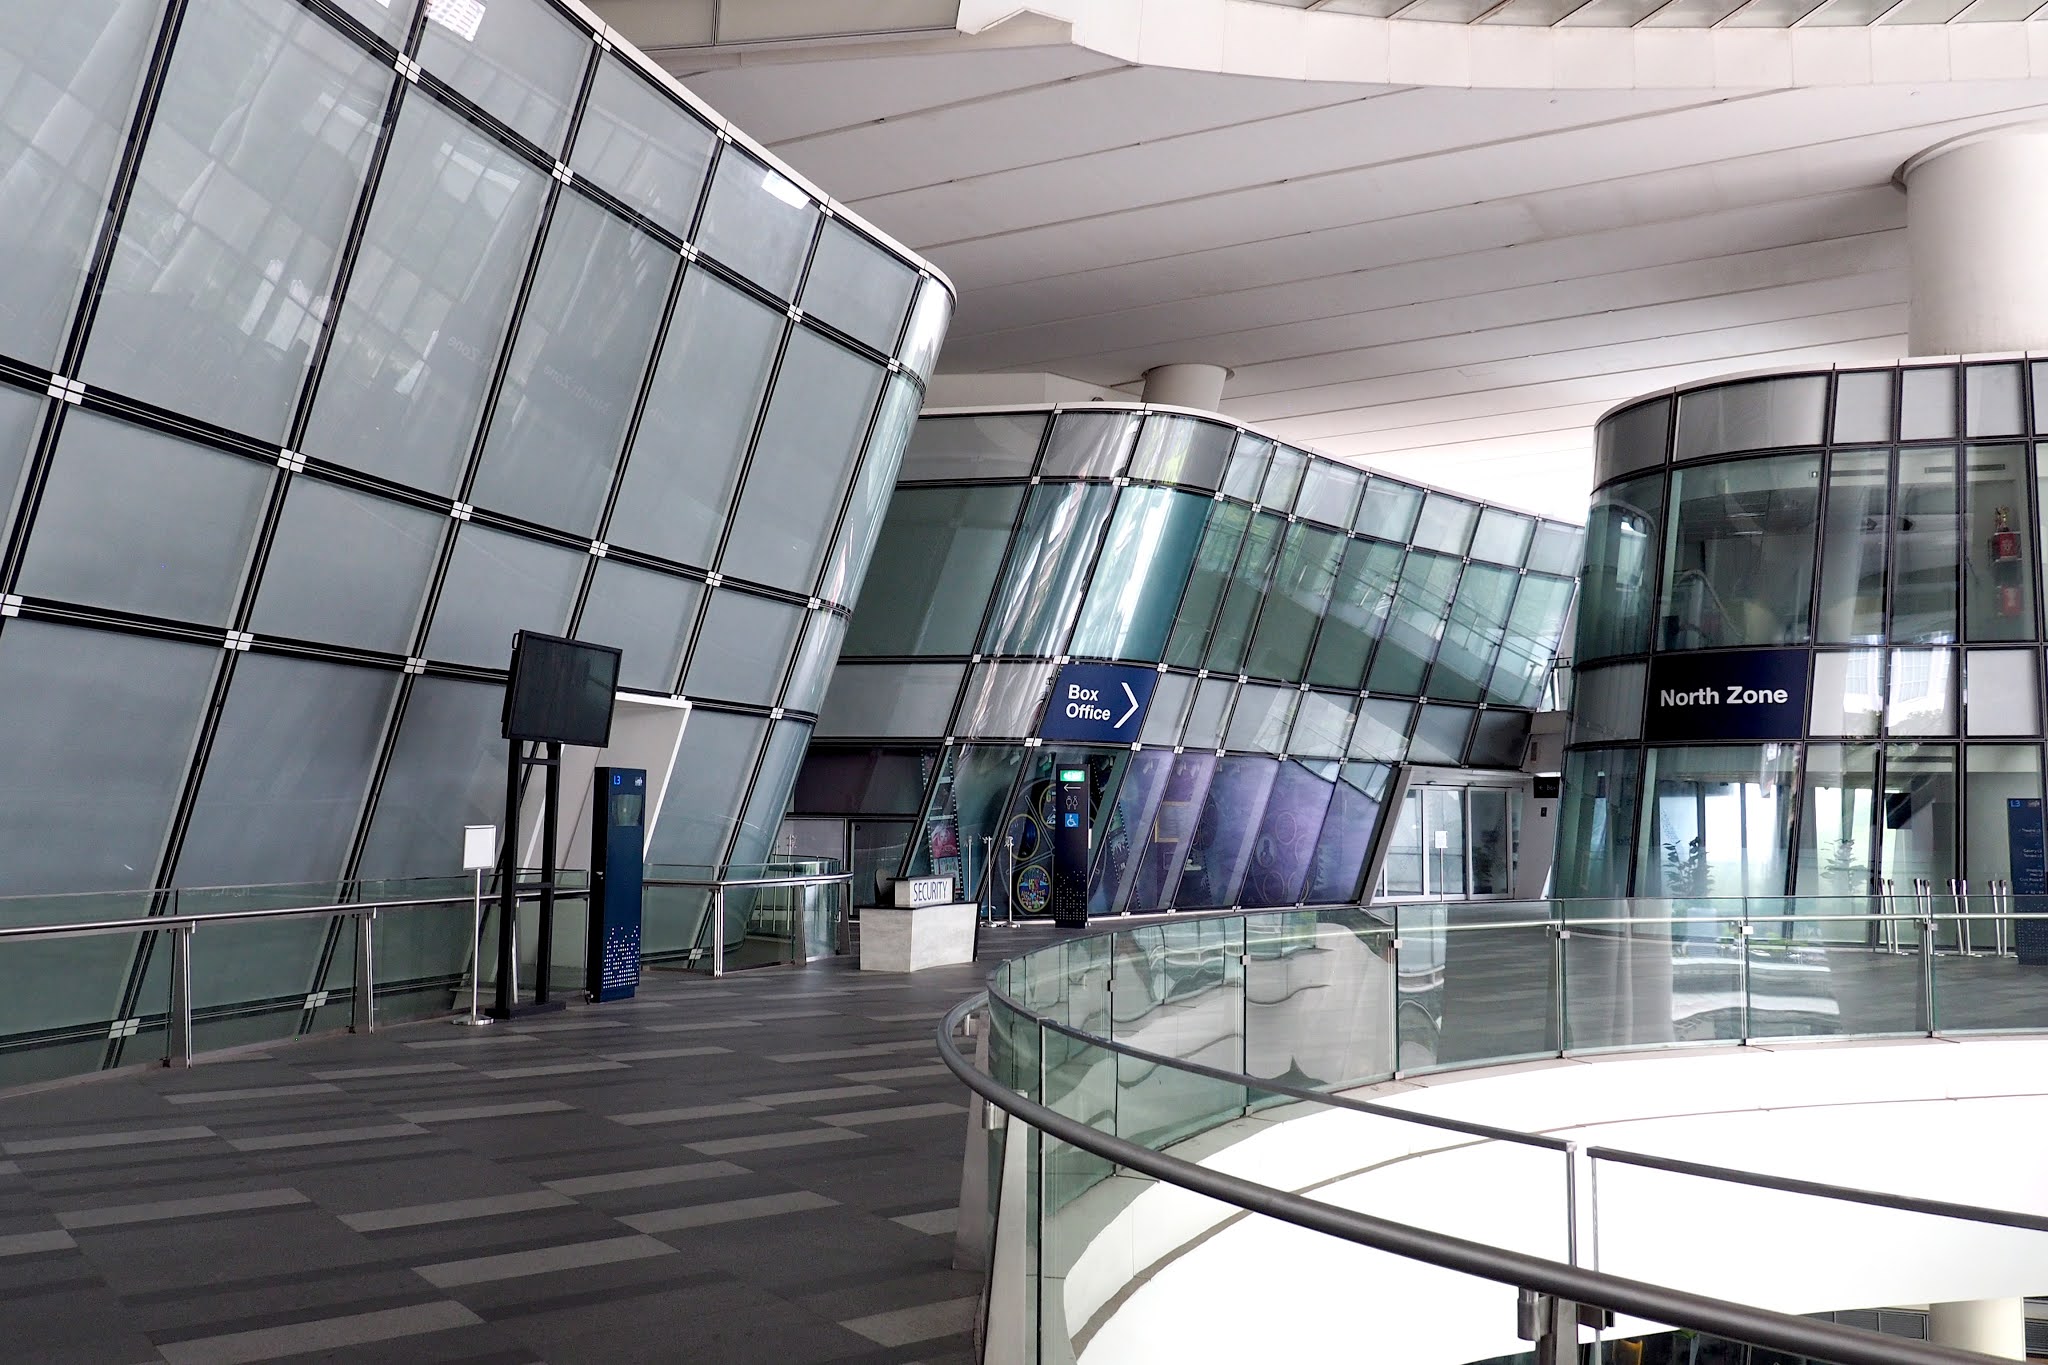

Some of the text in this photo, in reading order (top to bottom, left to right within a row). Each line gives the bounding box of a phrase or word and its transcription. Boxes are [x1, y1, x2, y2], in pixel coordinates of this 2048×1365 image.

[1068, 684, 1099, 702] Box
[1660, 685, 1788, 707] North Zone
[1065, 702, 1111, 721] Office
[613, 775, 621, 785] L3
[2010, 800, 2021, 808] L3
[913, 881, 948, 902] SECURITY
